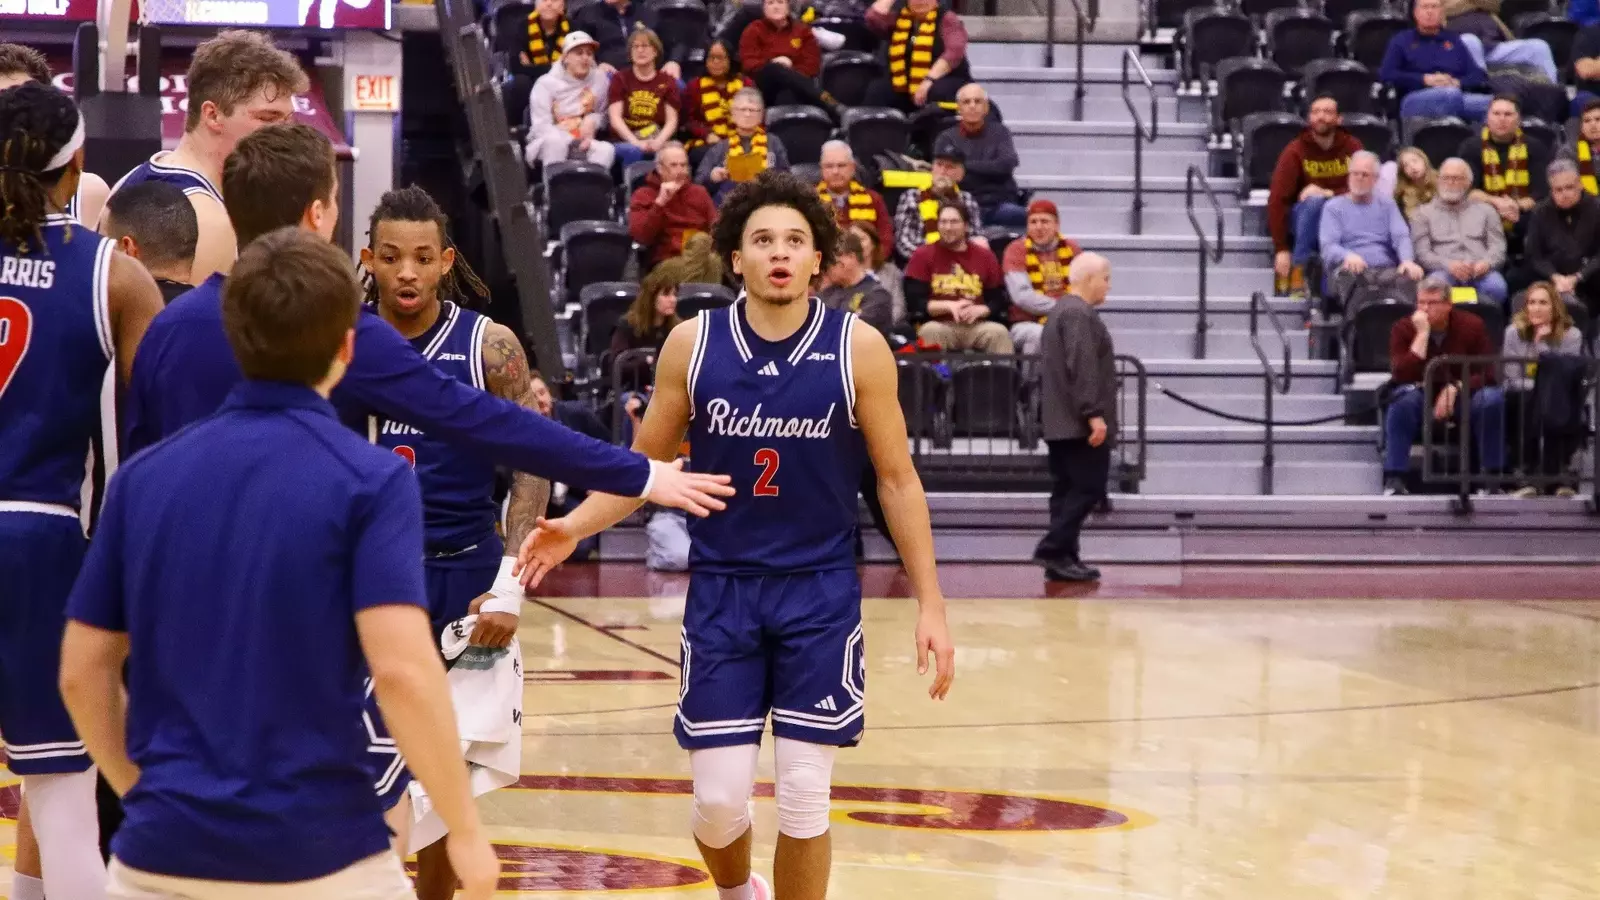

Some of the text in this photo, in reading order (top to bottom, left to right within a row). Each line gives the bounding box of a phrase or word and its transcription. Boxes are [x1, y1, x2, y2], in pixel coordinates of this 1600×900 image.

[355, 75, 393, 100] EXIT
[707, 397, 836, 439] Richmond
[753, 447, 780, 497] 2
